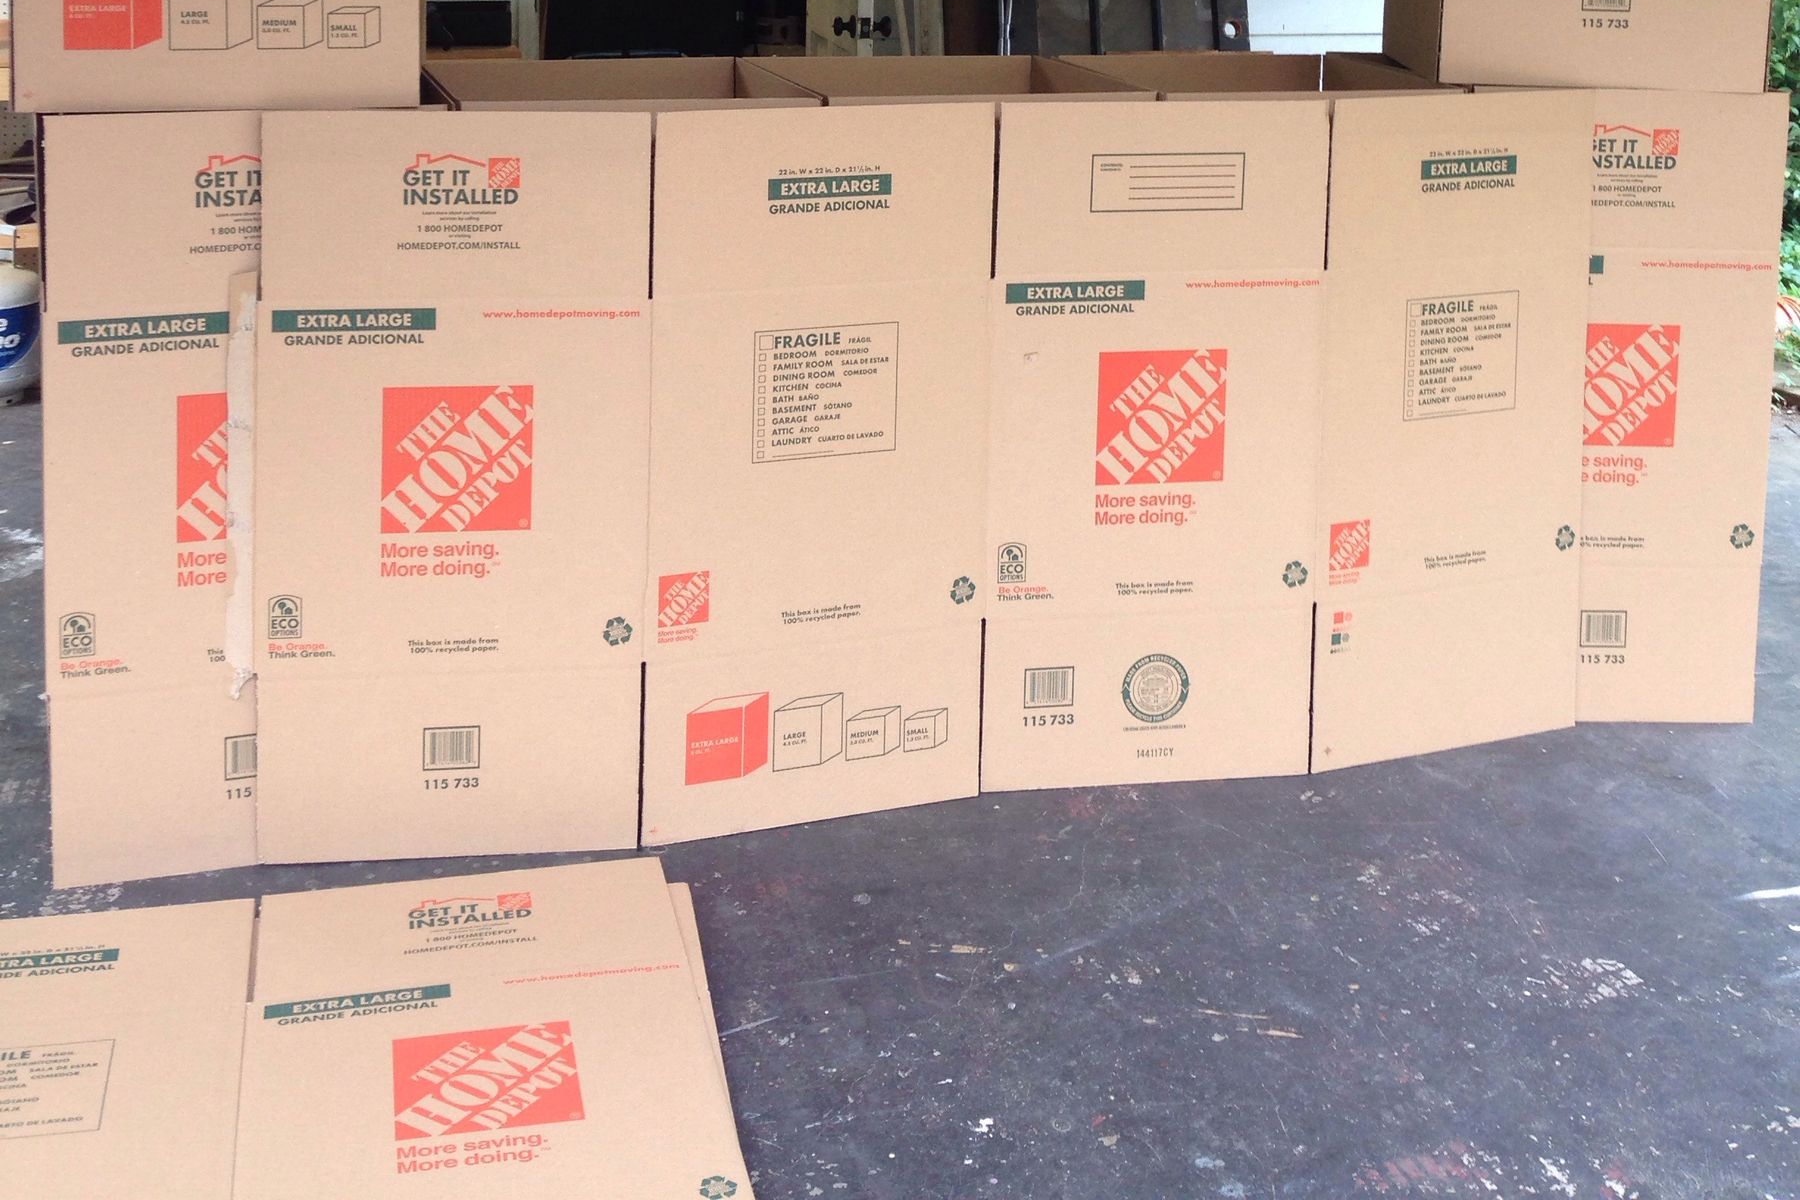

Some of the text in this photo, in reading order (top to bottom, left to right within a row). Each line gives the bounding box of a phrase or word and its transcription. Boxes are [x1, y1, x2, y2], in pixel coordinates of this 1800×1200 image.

[1581, 18, 1629, 29] 115 733
[1623, 139, 1638, 153] IT
[1431, 159, 1508, 176] EXTRA LARGE
[1593, 156, 1677, 169] NSTALLED
[194, 170, 261, 189] GET IT
[403, 170, 469, 186] GET IT
[1422, 178, 1515, 192] GRANDE ADICIONAL
[781, 179, 880, 196] EXTRA LARGE
[403, 189, 519, 205] INSTALLED
[769, 199, 890, 214] GRANDE ADICIONAL
[425, 224, 442, 232] 800
[444, 224, 503, 232] HOMEDEPOT
[397, 241, 520, 250] HOMEDEPOT.COM/INSTALL
[1642, 261, 1772, 271] www.homedepotmoving.com
[1026, 285, 1124, 300] EXTRA LARGE
[1185, 279, 1320, 290] www.homedepotmoving.com
[482, 309, 640, 319] www.homedepotmoving.com
[1016, 303, 1134, 316] GRANDE ADICIONAL
[1421, 300, 1474, 316] FRAGILE
[84, 318, 206, 339] EXTRA LARGE
[297, 313, 412, 328] EXTRA LARGE
[72, 338, 219, 357] GRANDE ADICIONAL
[284, 333, 424, 346] GRANDE ADICIONAL
[774, 332, 841, 349] FRAGILE
[774, 348, 869, 360] BEDROOM DORMITORIO
[773, 362, 803, 371] FAMILY
[773, 373, 805, 381] DINING
[808, 371, 835, 379] ROOM
[773, 384, 809, 392] KITCHEN
[1109, 363, 1166, 420] THE
[772, 405, 816, 414] BASEMENT
[1600, 369, 1678, 447] DEPOT
[772, 416, 807, 425] GARAGE
[1095, 349, 1228, 485] HOME
[396, 400, 461, 461] THE
[772, 437, 812, 447] LAUNDRY
[856, 431, 884, 439] LAVADO
[1146, 397, 1227, 484] DEPOT
[381, 384, 534, 533] HOME
[1593, 455, 1648, 471] saving.
[440, 439, 533, 533] DEPOT
[1592, 469, 1640, 487] doing.
[1095, 492, 1196, 508] More saving.
[1095, 509, 1188, 526] More doing.
[381, 541, 499, 559] More saving.
[381, 561, 490, 578] More doing.
[1000, 564, 1024, 574] ECO
[1000, 573, 1023, 581] OPTIONS
[667, 580, 684, 600] THE
[999, 585, 1049, 594] Be Orange.
[1024, 592, 1054, 600] Green.
[658, 570, 710, 628] HOME
[678, 590, 709, 626] DEPOT
[271, 618, 299, 629] ECO
[63, 636, 92, 648] ECO
[1580, 654, 1625, 664] 115 733
[1023, 714, 1074, 727] 115 733
[783, 731, 806, 740] LARGE
[850, 729, 879, 738] MEDIUM
[906, 727, 928, 736] SMALL
[424, 778, 479, 790] 115 733
[226, 786, 252, 799] 115
[408, 903, 479, 921] GET IT
[409, 908, 532, 930] INSTALLED
[403, 936, 539, 955] HOMEDEPOT.COM/INSTALL
[40, 951, 104, 966] LARGE
[28, 963, 115, 977] ADICIONAL
[503, 962, 681, 986] www.homedepotmoving.com
[292, 989, 423, 1014] EXTRA LARGE
[277, 1000, 438, 1026] GRANDE ADICIONAL
[412, 1039, 487, 1086] THE
[394, 1023, 574, 1139] HOME
[470, 1057, 579, 1131] DEPOT
[397, 1133, 549, 1161] More saving.
[397, 1148, 540, 1174] More doing.
